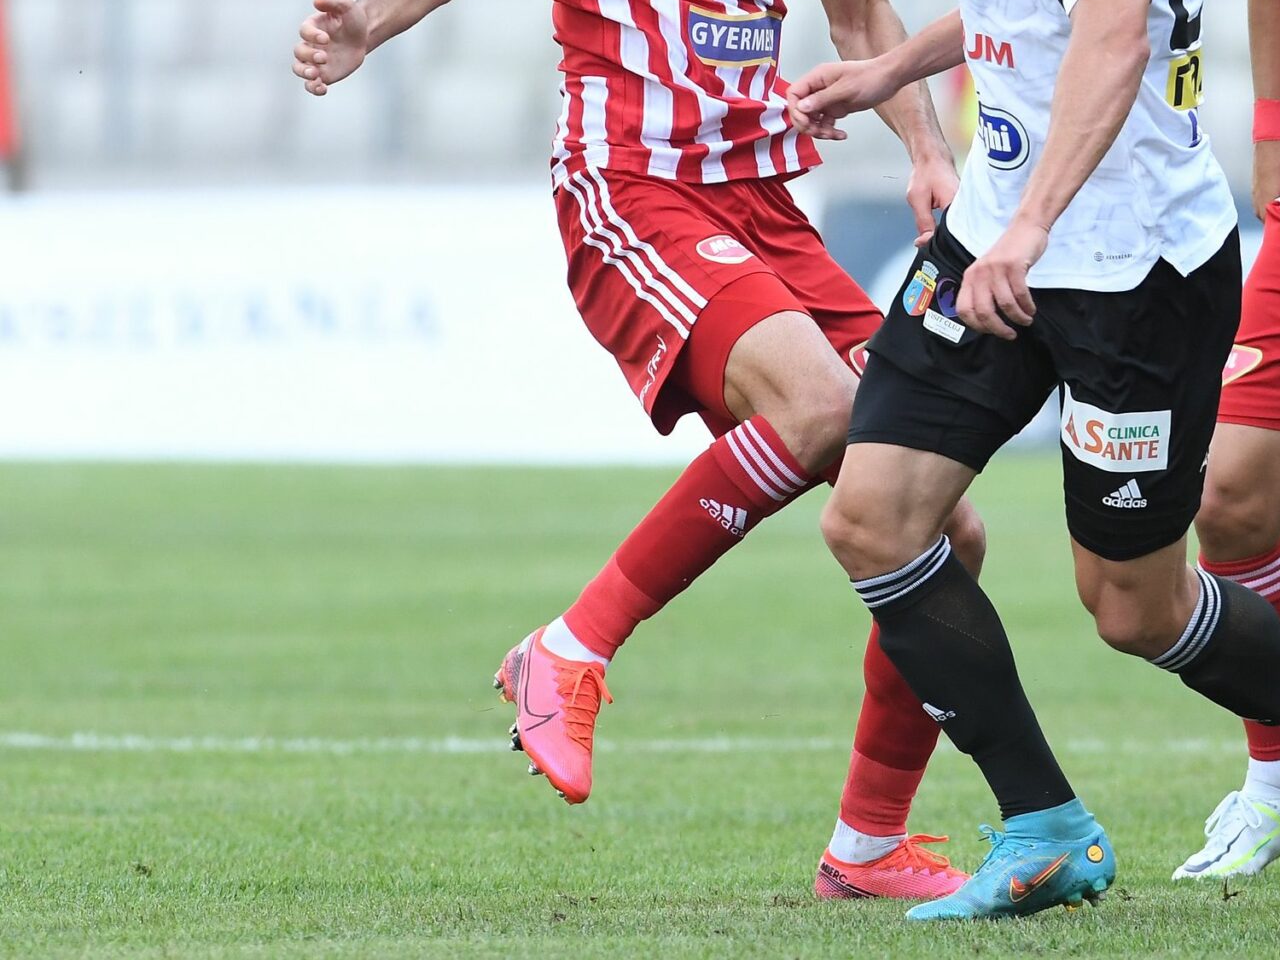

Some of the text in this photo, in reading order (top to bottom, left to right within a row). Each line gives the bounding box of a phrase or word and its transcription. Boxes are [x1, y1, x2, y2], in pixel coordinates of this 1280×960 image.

[1083, 419, 1160, 461] SANTE
[1107, 425, 1160, 440] CLINICA
[1102, 496, 1148, 509] adidas
[699, 498, 745, 538] adidas
